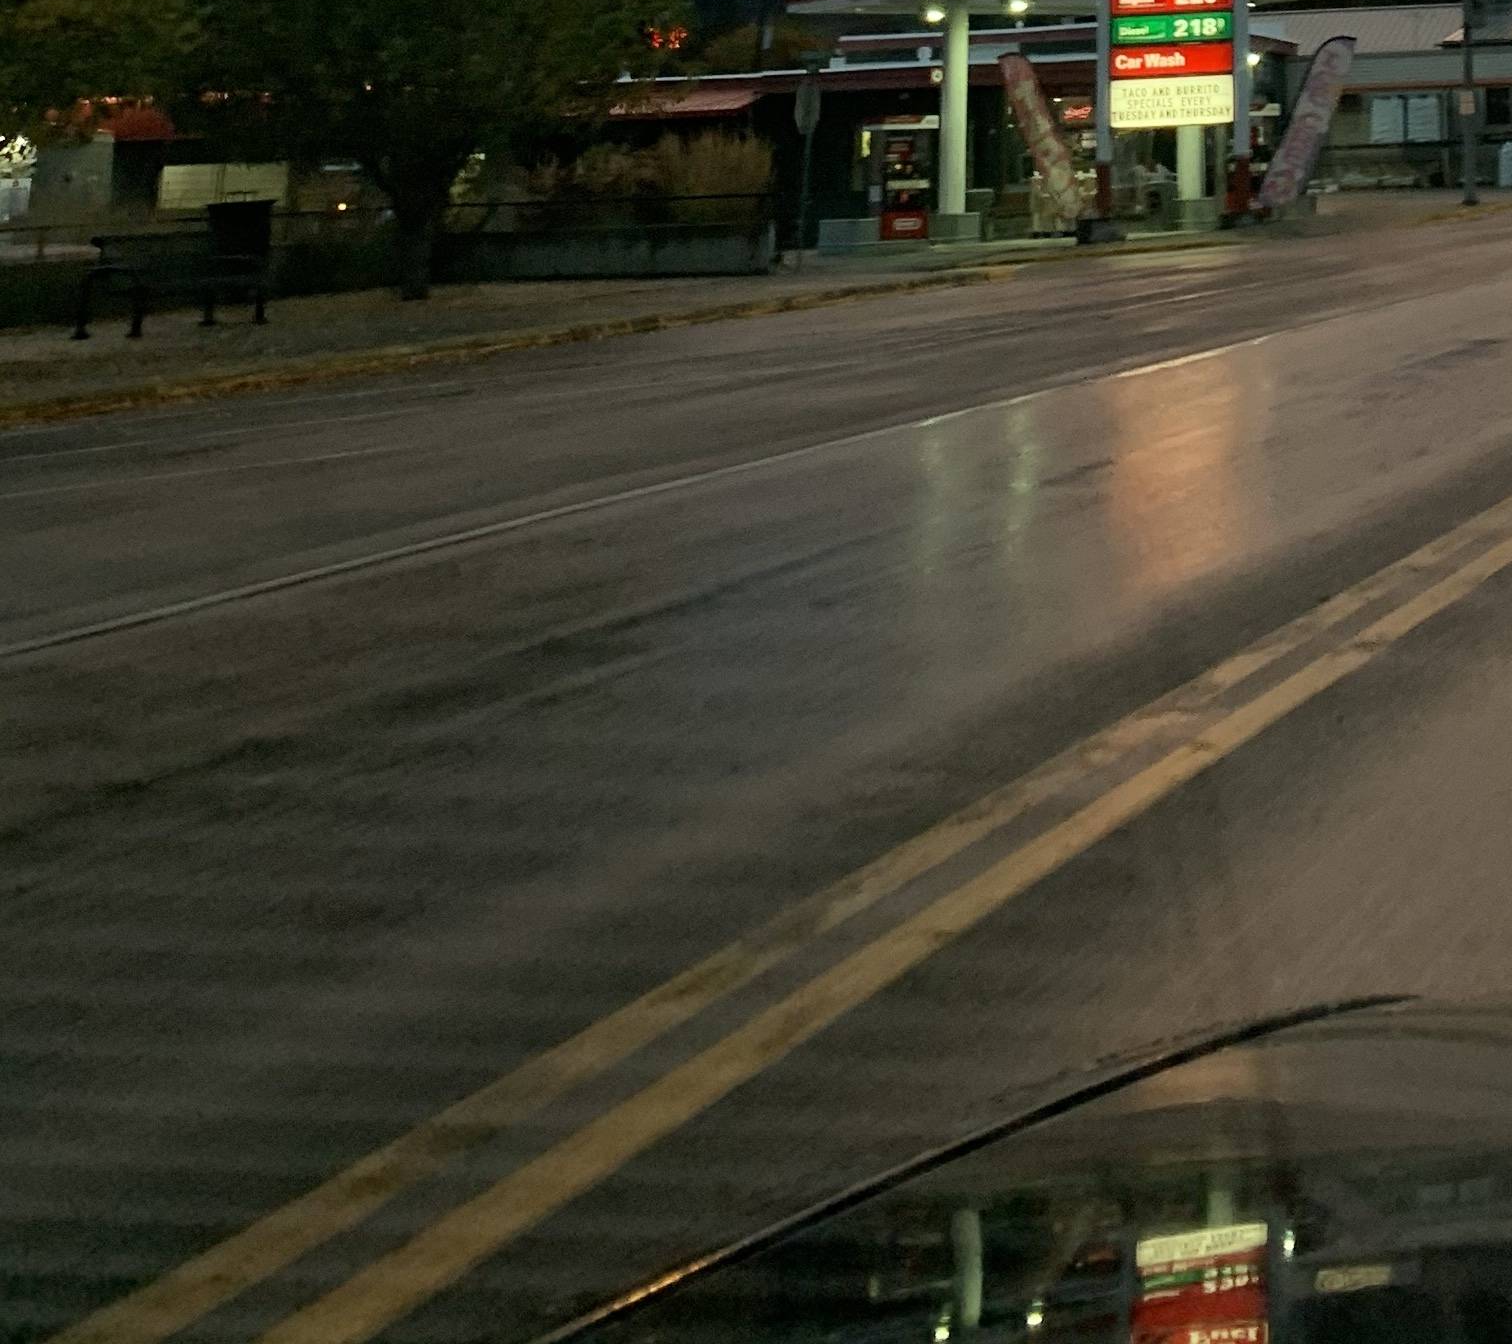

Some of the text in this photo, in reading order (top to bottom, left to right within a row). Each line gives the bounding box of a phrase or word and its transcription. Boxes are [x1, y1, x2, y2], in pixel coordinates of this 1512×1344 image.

[1115, 51, 1186, 70] Car Wash
[1122, 84, 1220, 98] TACO AND BURRITO
[1127, 96, 1212, 110] SPECIALS EVERY
[1112, 106, 1231, 123] TUESDAY AND THURSDAY
